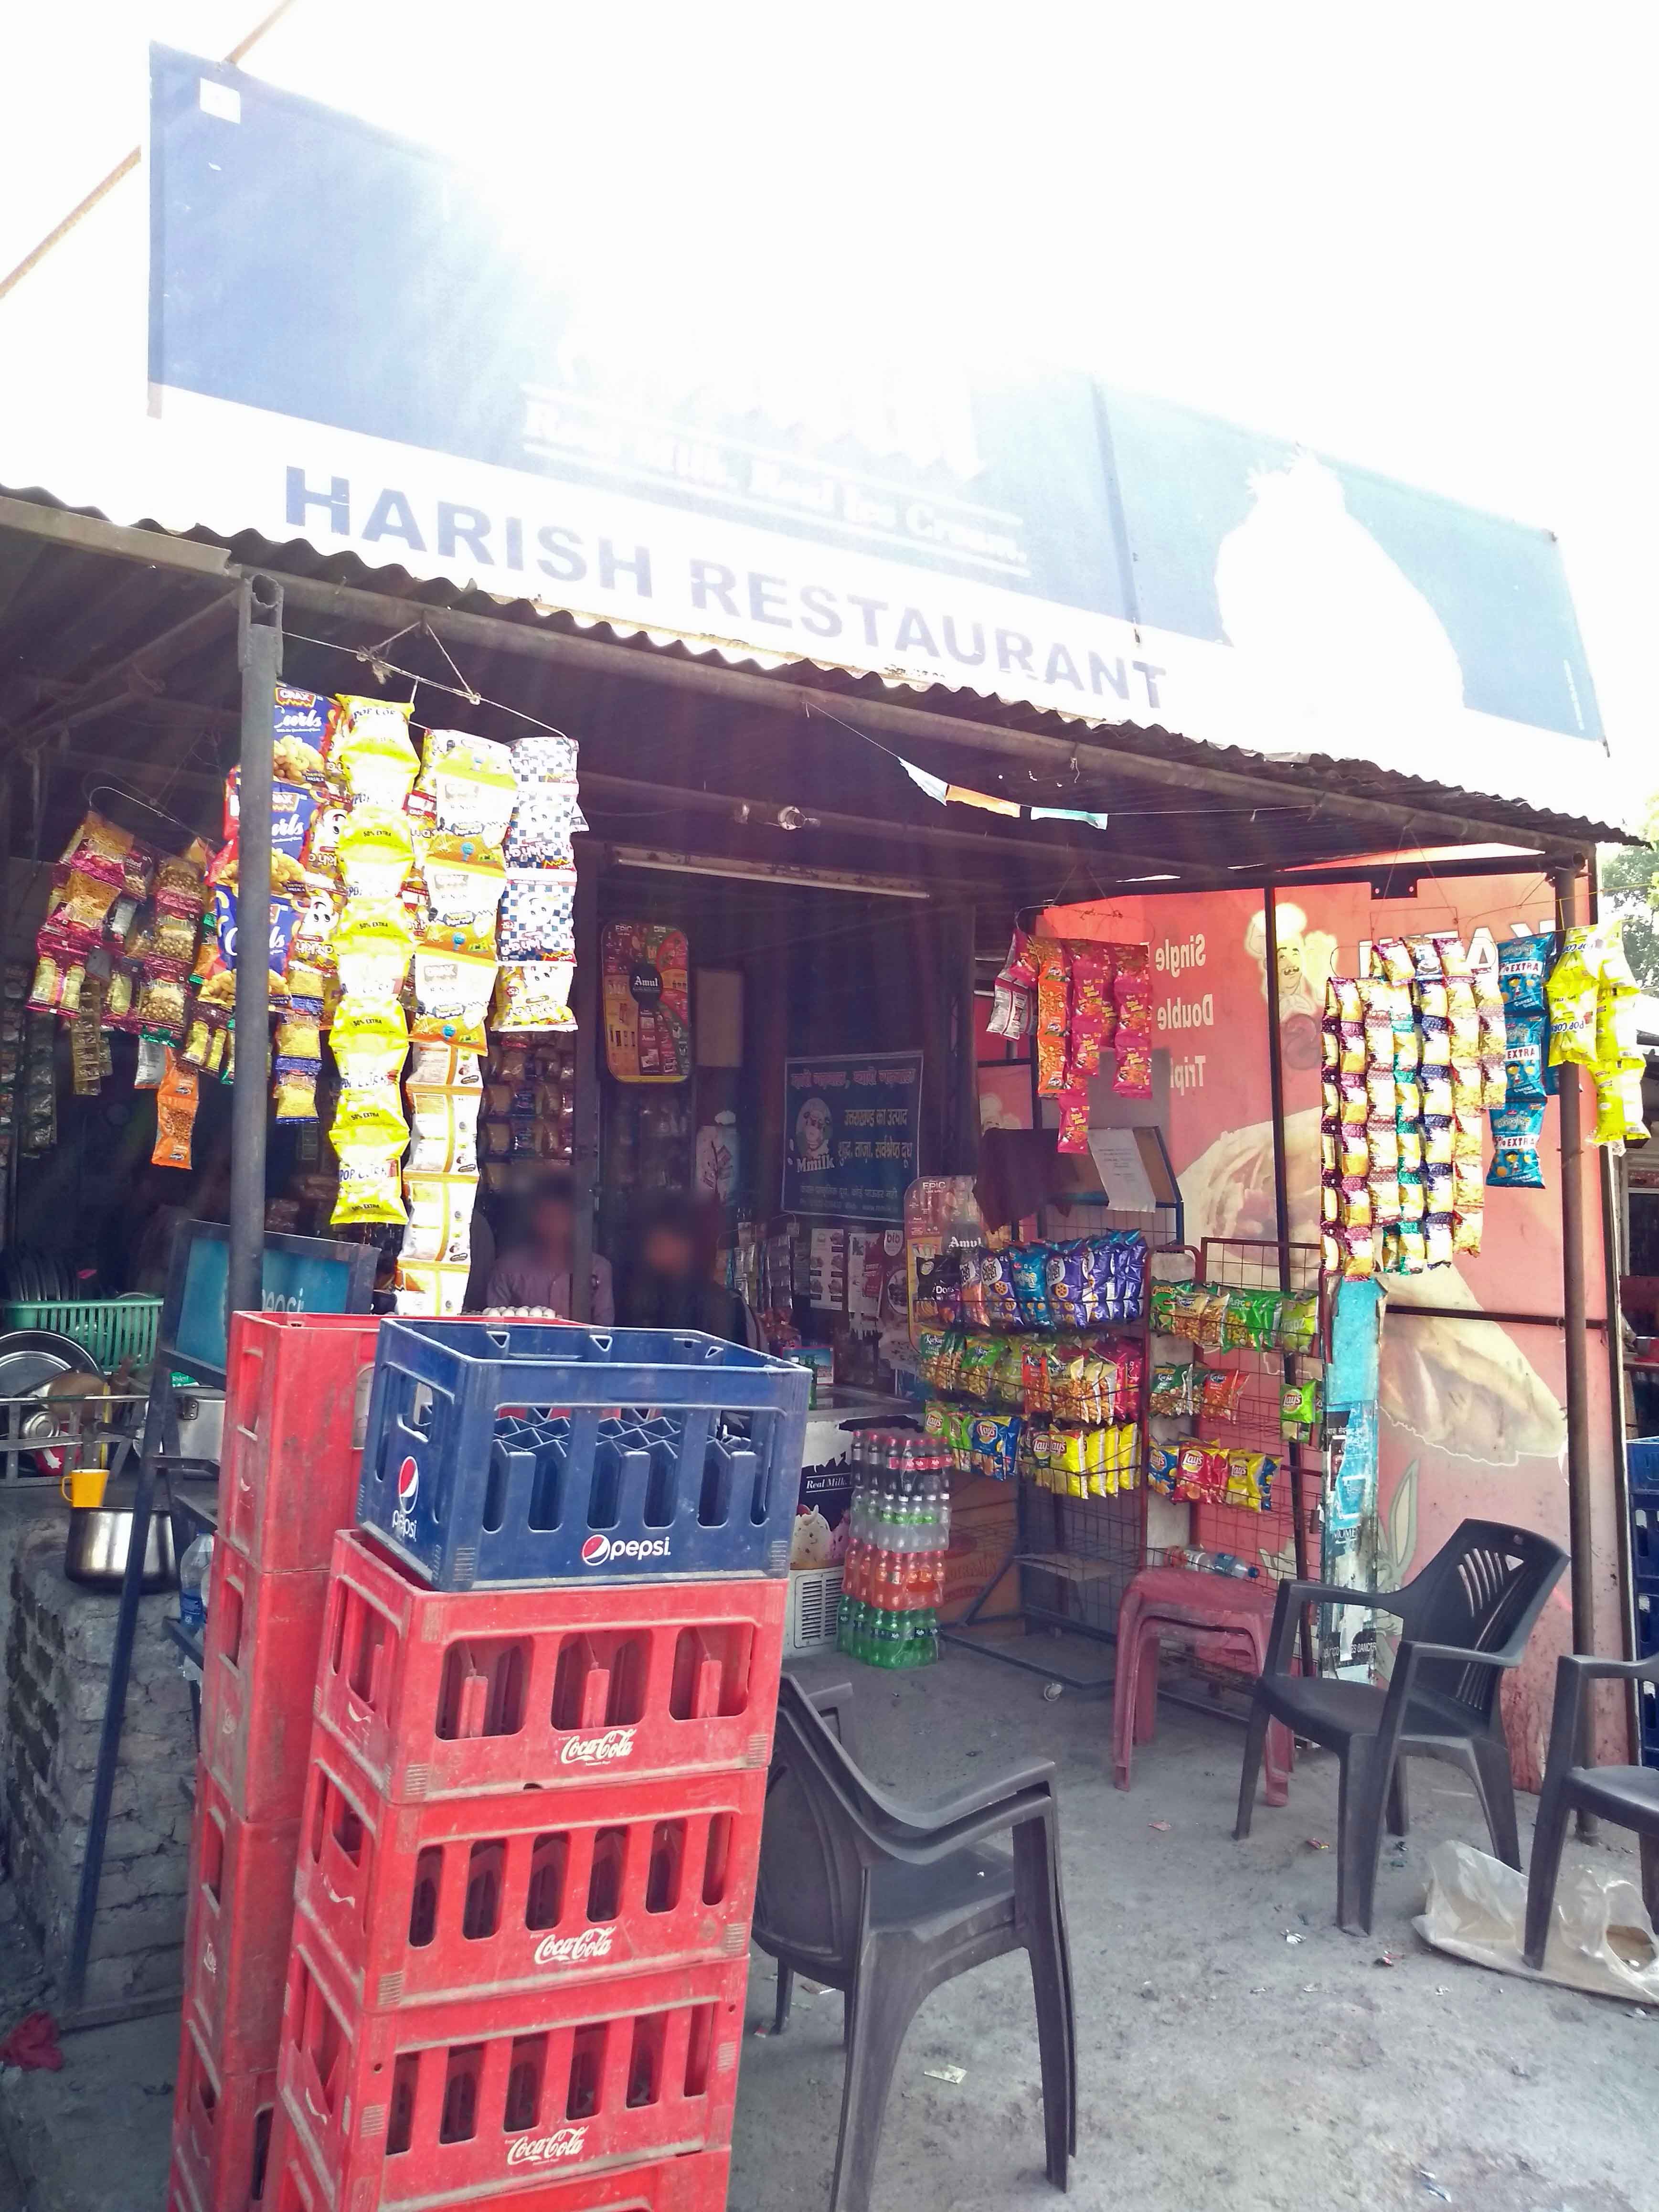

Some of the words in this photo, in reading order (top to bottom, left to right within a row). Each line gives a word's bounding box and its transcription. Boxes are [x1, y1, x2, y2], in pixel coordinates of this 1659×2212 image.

[287, 466, 653, 598] HARISH
[690, 558, 1166, 709] RESTAURANT
[280, 689, 310, 702] CRAX
[272, 813, 304, 835] urls
[1510, 962, 1539, 972] EXTRA
[634, 976, 659, 987] Amul
[1507, 1048, 1535, 1059] EXTRA
[922, 1181, 946, 1189] EPIC
[948, 1236, 982, 1248] Amul
[262, 1287, 304, 1312] epsi
[1283, 1394, 1302, 1406] Lay's
[925, 1414, 943, 1427] Lay's
[979, 1425, 997, 1437] Lay's
[1033, 1439, 1050, 1452] Lay'
[1182, 1453, 1203, 1466] Lay's
[1231, 1465, 1247, 1476] Lay's
[806, 1479, 826, 1489] Real
[610, 1536, 671, 1560] pepsi
[561, 1728, 638, 1765] Coca-Cola
[534, 1925, 617, 1965] Coca-Cola
[507, 2125, 590, 2166] Coca-Cola
